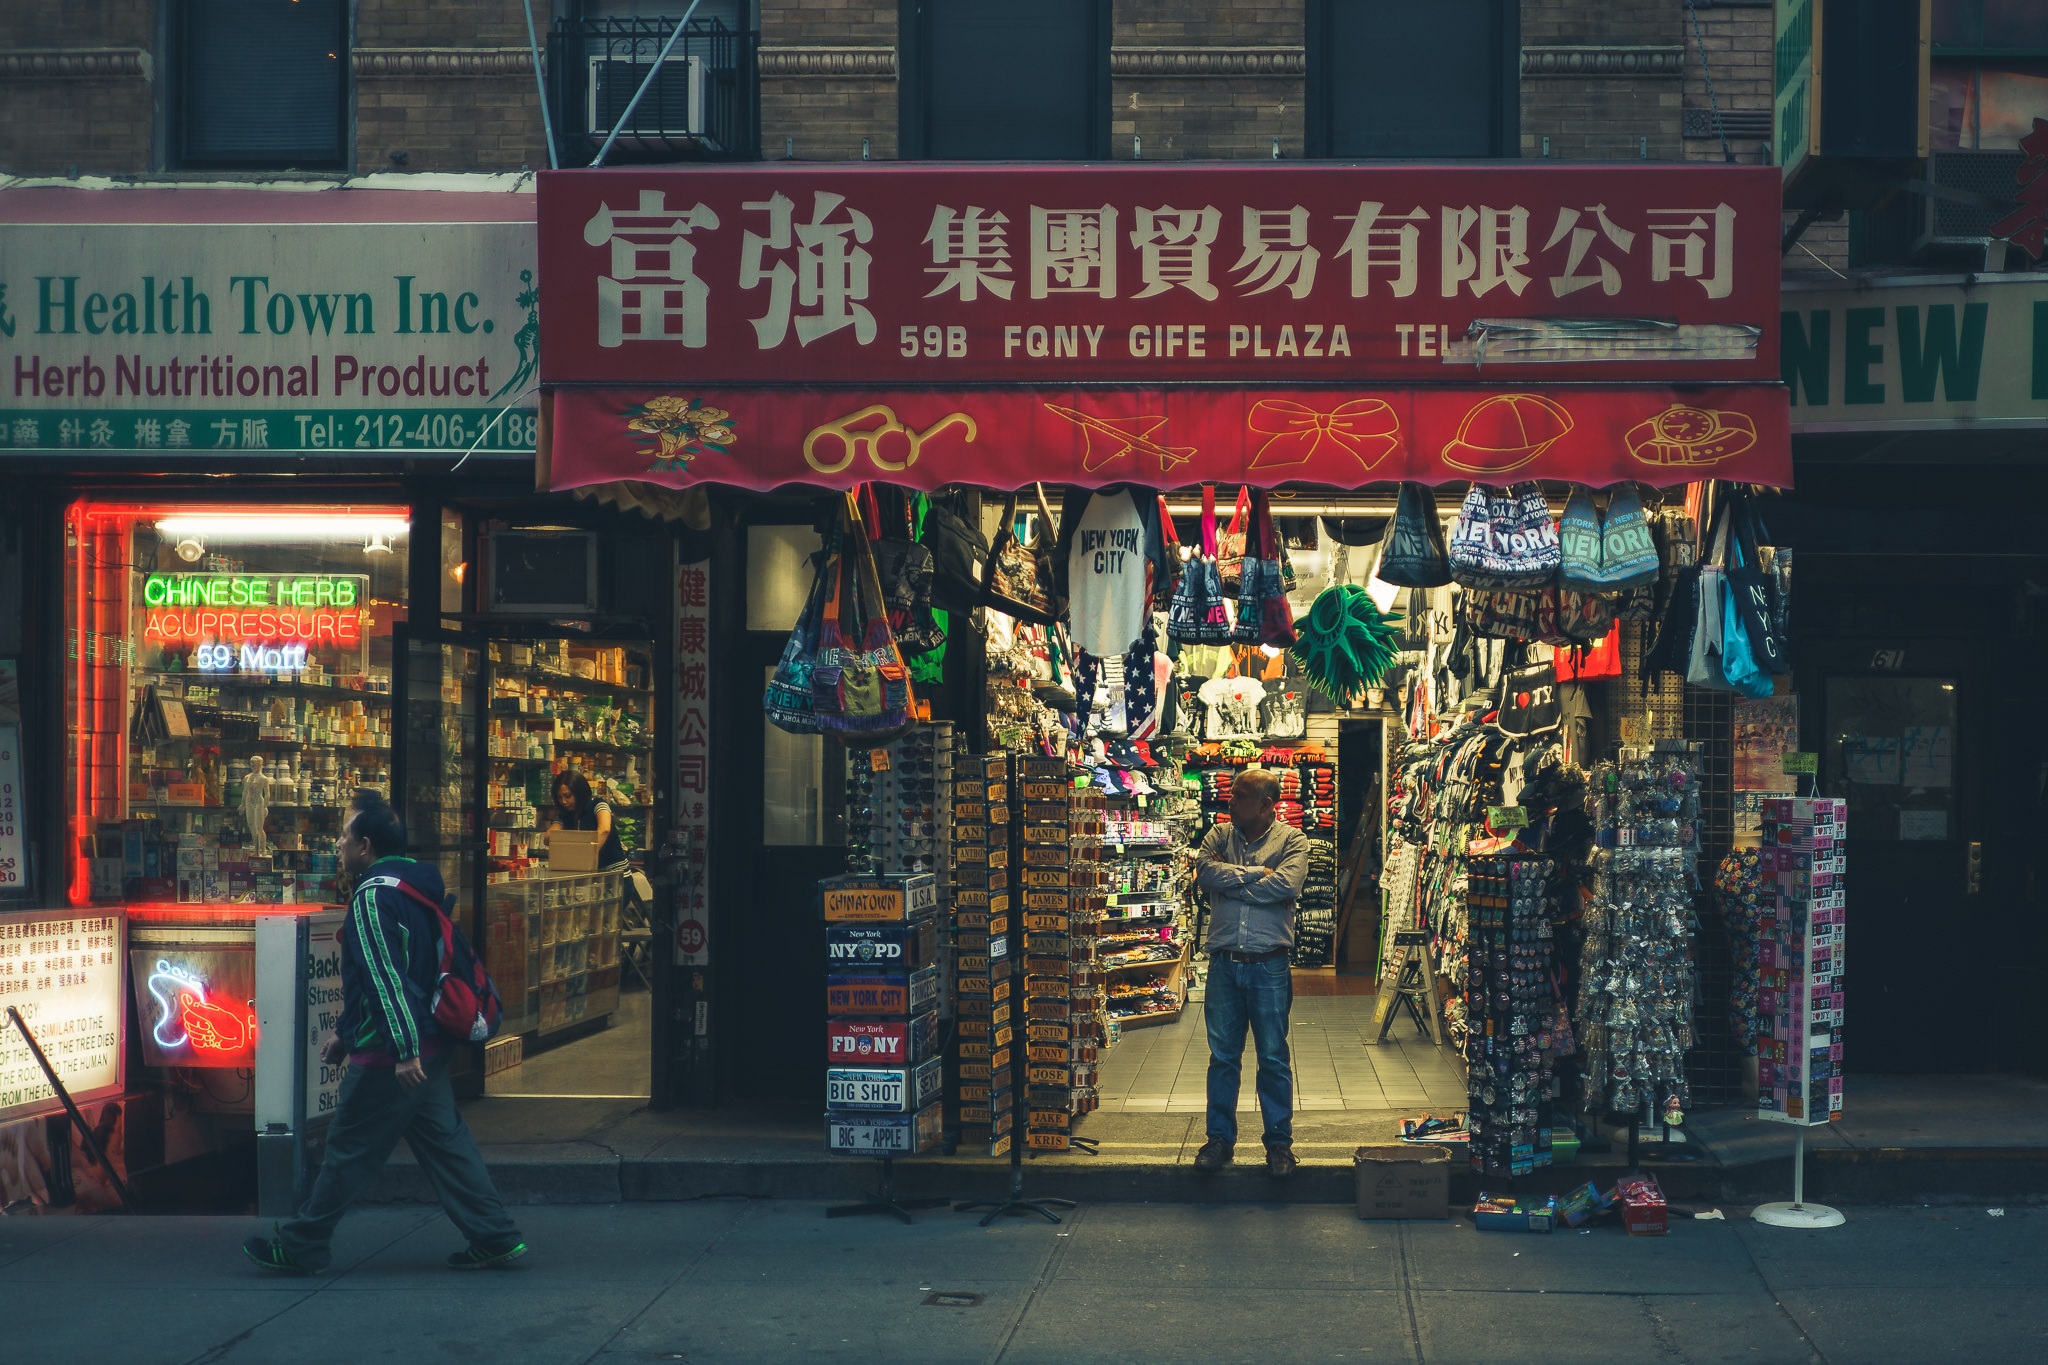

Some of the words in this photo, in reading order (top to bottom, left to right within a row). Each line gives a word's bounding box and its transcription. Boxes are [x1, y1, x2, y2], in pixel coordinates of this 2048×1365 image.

[584, 189, 877, 350] 富強
[921, 201, 1736, 301] 集團貿易有限公司
[35, 275, 213, 335] Health
[230, 276, 375, 337] Town
[394, 275, 495, 335] Inc.
[900, 325, 968, 358] 59B
[1004, 325, 1105, 358] FQNY
[1129, 325, 1206, 358] GIFE
[1229, 324, 1352, 357] PLAZA
[1781, 303, 1989, 407] NEW
[15, 355, 106, 398] Herb
[116, 354, 319, 398] Nutritional
[334, 355, 490, 398] Product
[294, 415, 344, 447] Tel:
[1081, 529, 1107, 557] NEW
[1110, 528, 1139, 556] YORK
[1495, 523, 1560, 554] YORK
[1094, 550, 1126, 574] CITY
[145, 576, 269, 606] CHINESE
[277, 577, 356, 607] HERB
[145, 612, 358, 639] ACUPRESSURE
[196, 645, 230, 670] 59
[239, 644, 308, 671] Mott
[1029, 784, 1060, 794] JOEY
[1030, 828, 1061, 838] JANET
[1030, 851, 1060, 861] JASON
[1033, 872, 1060, 882] JON
[829, 893, 896, 911] CHINATOWN
[1031, 895, 1064, 905] JAMES
[1034, 916, 1059, 926] JIM
[681, 927, 702, 946] 59
[866, 930, 881, 938] York
[1031, 939, 1062, 948] JANE
[307, 951, 341, 980] Back
[309, 986, 345, 1006] Stress
[830, 990, 850, 1006] NEW
[853, 990, 877, 1006] YORK
[881, 990, 902, 1006] CITY
[1031, 984, 1065, 992] JACKSON
[41, 1020, 75, 1039] SIMILAR
[77, 1018, 87, 1033] TO
[88, 1015, 104, 1030] THE
[318, 1010, 339, 1032] Wei
[849, 1025, 865, 1033] New
[867, 1024, 884, 1033] York
[1033, 1027, 1063, 1036] JUSTIN
[13, 1047, 30, 1063] THE
[58, 1039, 74, 1055] THE
[76, 1035, 96, 1052] TREE
[97, 1032, 115, 1048] DIES
[1032, 1048, 1064, 1058] JENNY
[17, 1064, 41, 1083] ROOT
[63, 1058, 78, 1074] THE
[80, 1052, 108, 1070] HUMAN
[319, 1064, 351, 1085] Deto
[1033, 1069, 1064, 1080] JOSE
[24, 1084, 41, 1102] THE
[318, 1090, 339, 1113] Ski
[830, 1083, 855, 1100] BIG
[861, 1083, 900, 1101] SHOT
[1034, 1113, 1063, 1123] JAKE
[839, 1127, 855, 1146] BIG
[872, 1128, 902, 1148] APPLE
[1034, 1135, 1063, 1145] KRIS
